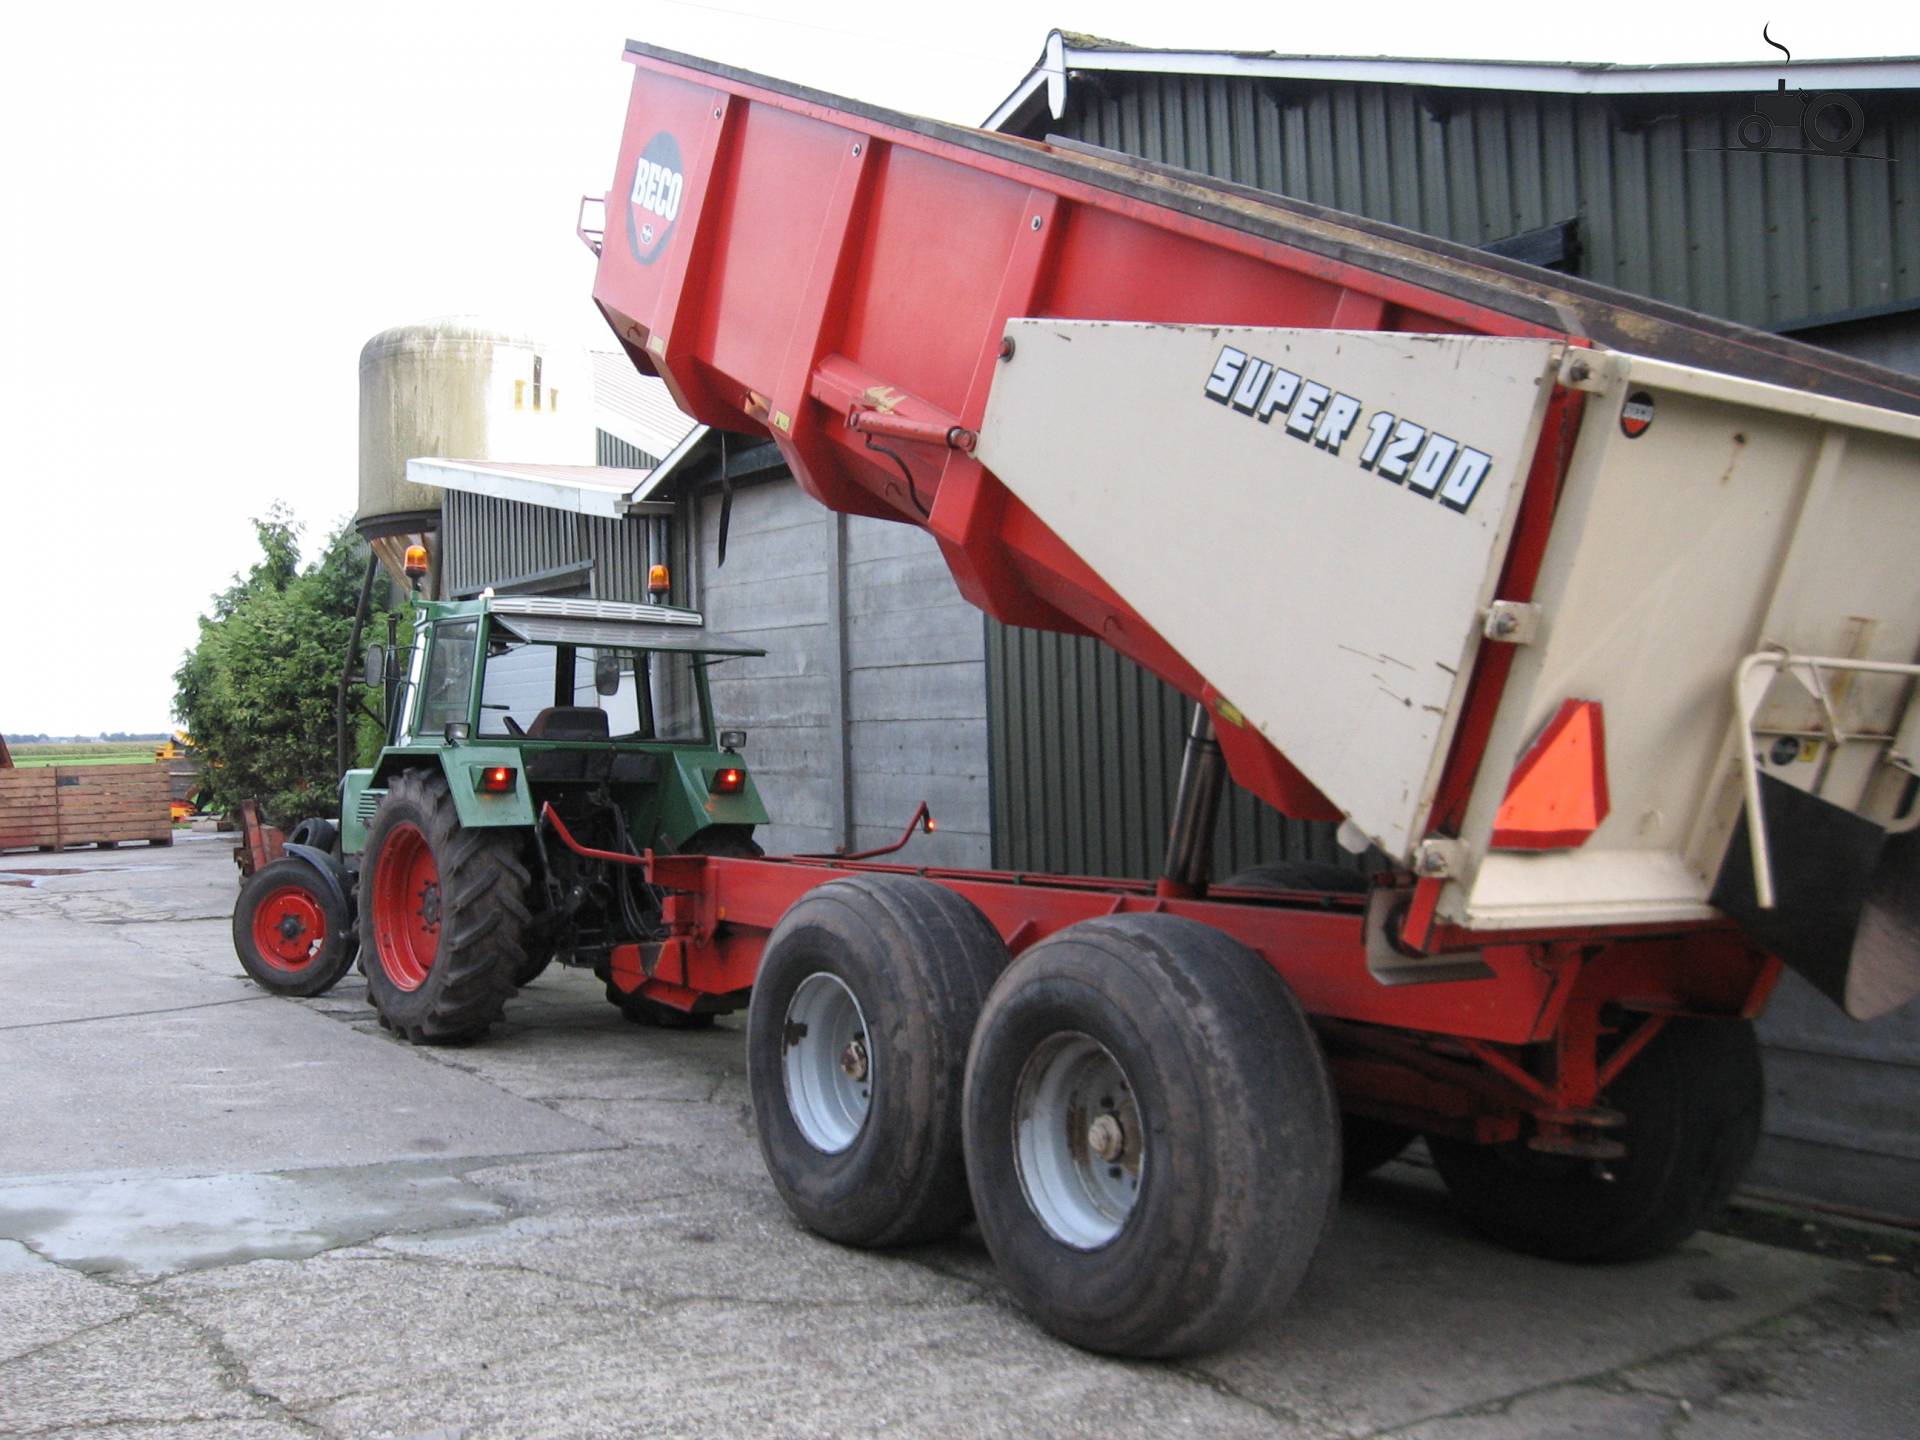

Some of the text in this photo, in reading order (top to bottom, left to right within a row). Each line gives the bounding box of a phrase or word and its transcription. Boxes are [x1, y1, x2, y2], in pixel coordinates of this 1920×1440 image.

[632, 158, 683, 221] BECO
[1204, 345, 1492, 514] SUPER 1200
